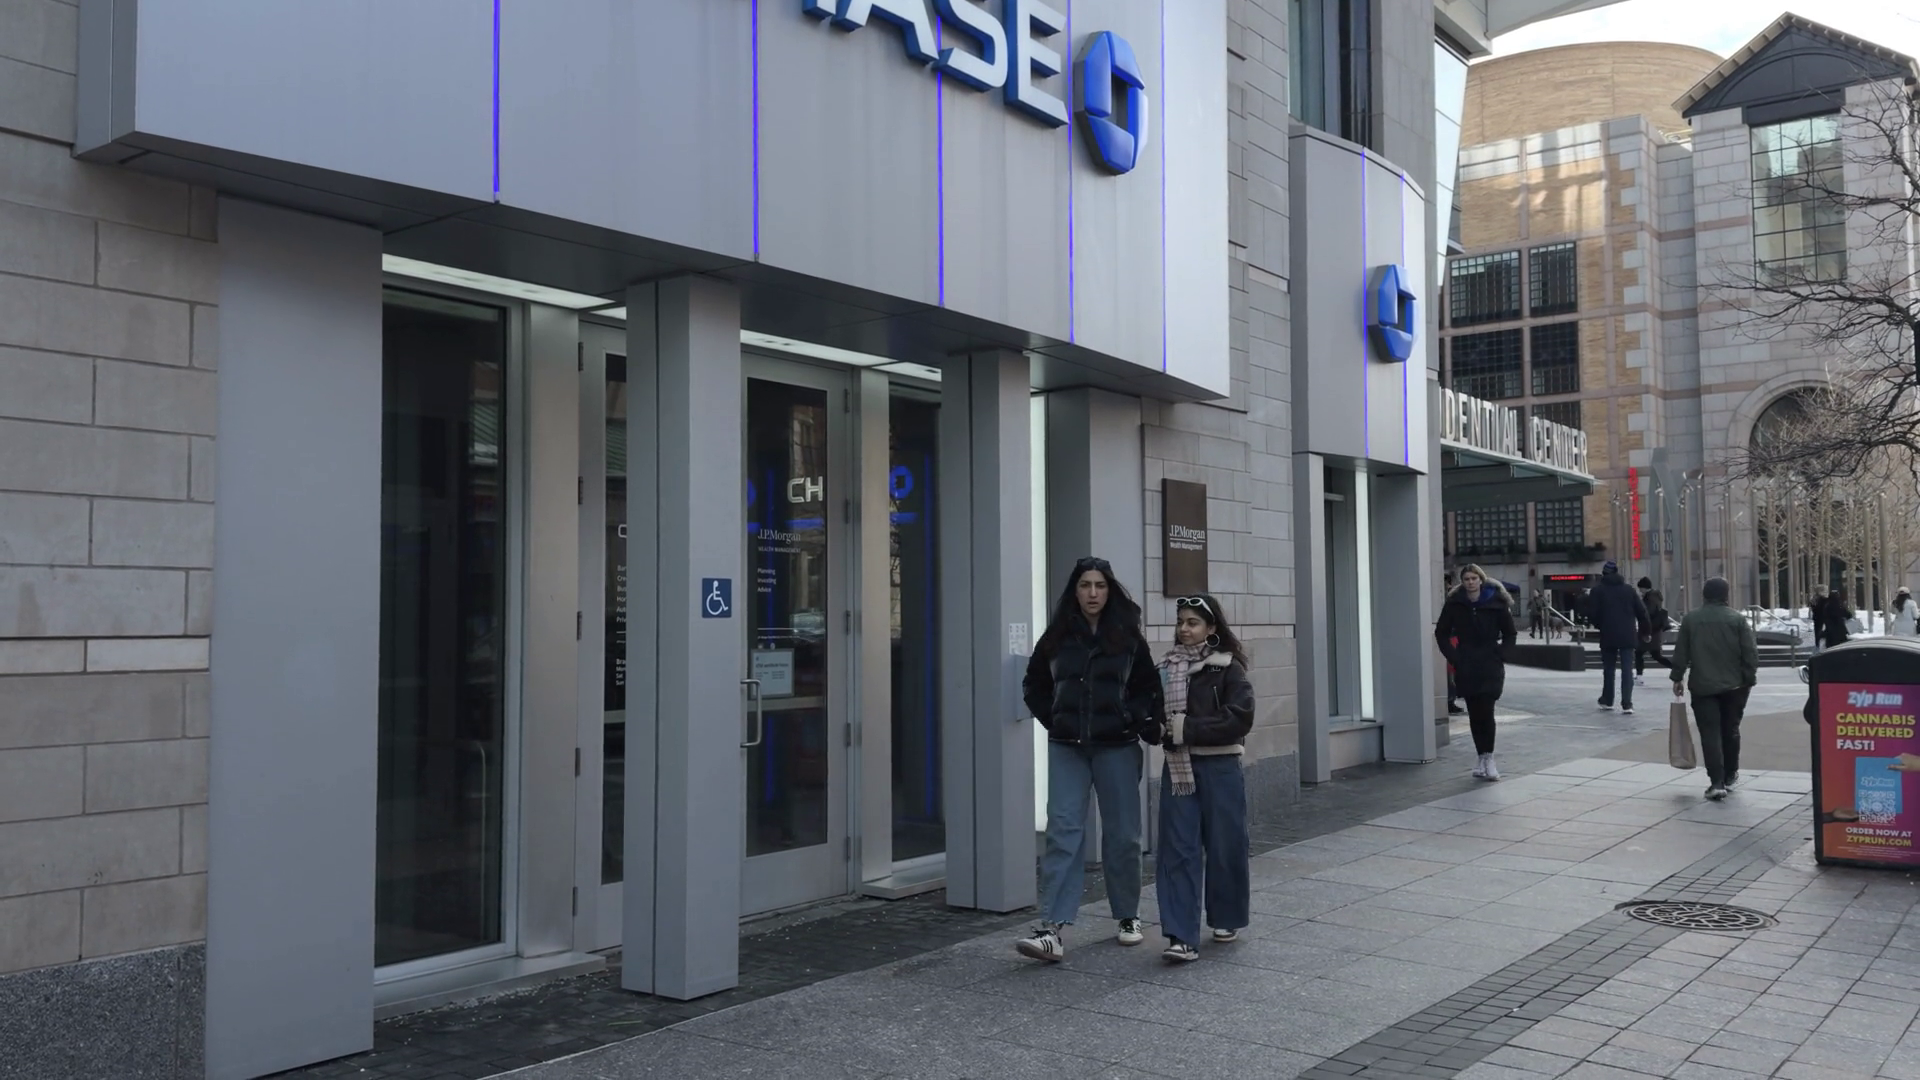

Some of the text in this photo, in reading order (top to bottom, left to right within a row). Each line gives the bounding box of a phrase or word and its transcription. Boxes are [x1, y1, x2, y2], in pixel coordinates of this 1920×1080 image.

[1529, 416, 1588, 475] CENTER
[1847, 690, 1902, 707] Zyp Run
[1836, 713, 1916, 725] CANNABIS
[1836, 725, 1914, 739] DELIVERED
[1836, 739, 1875, 751] FAST!
[1846, 827, 1875, 836] ORDER
[1876, 829, 1900, 837] NOW
[1847, 835, 1912, 847] ZYPRUN.COM
